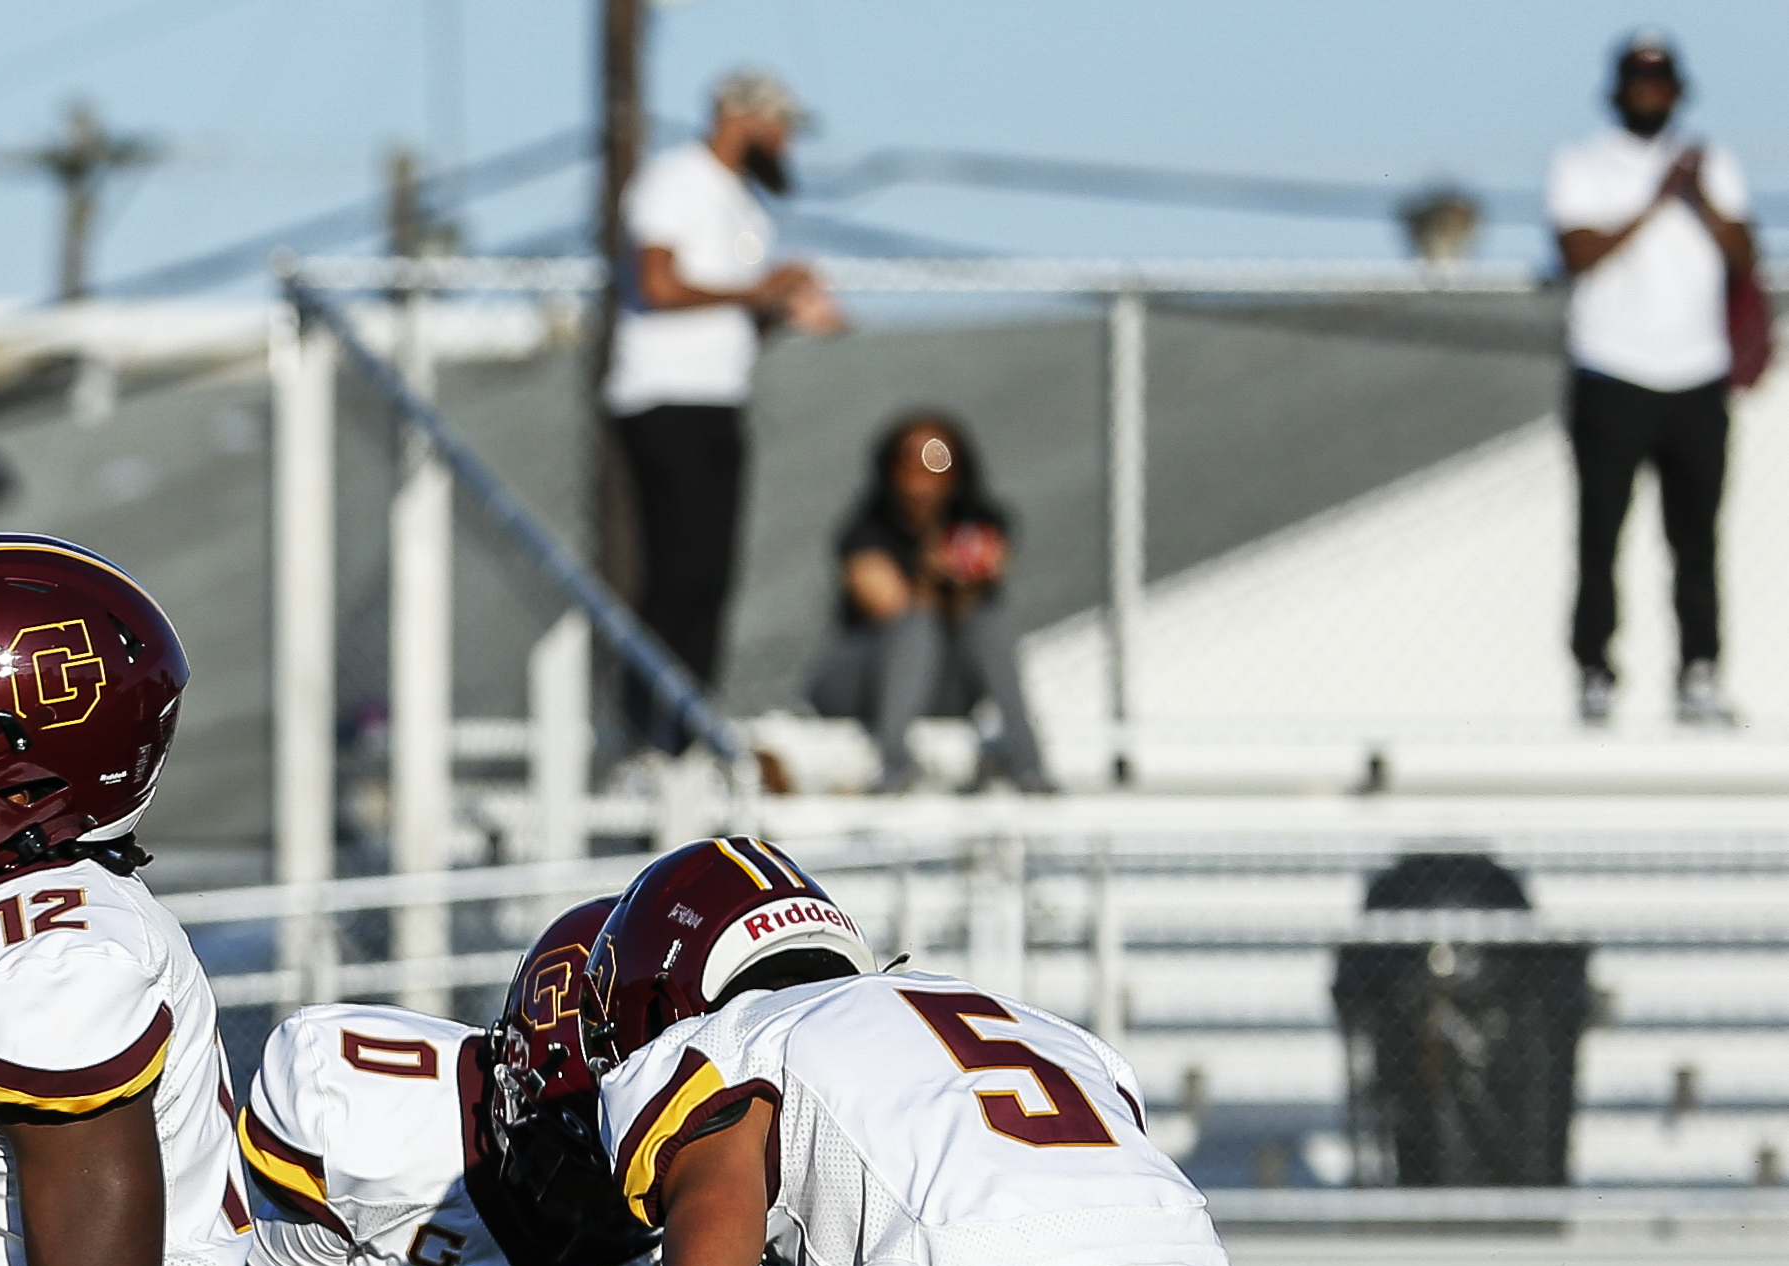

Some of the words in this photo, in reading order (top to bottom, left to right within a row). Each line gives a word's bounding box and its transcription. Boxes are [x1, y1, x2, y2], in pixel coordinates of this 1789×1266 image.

[10, 618, 108, 731] G
[742, 901, 860, 942] Riddell
[340, 1027, 439, 1080] 0
[894, 987, 1121, 1148] 5
